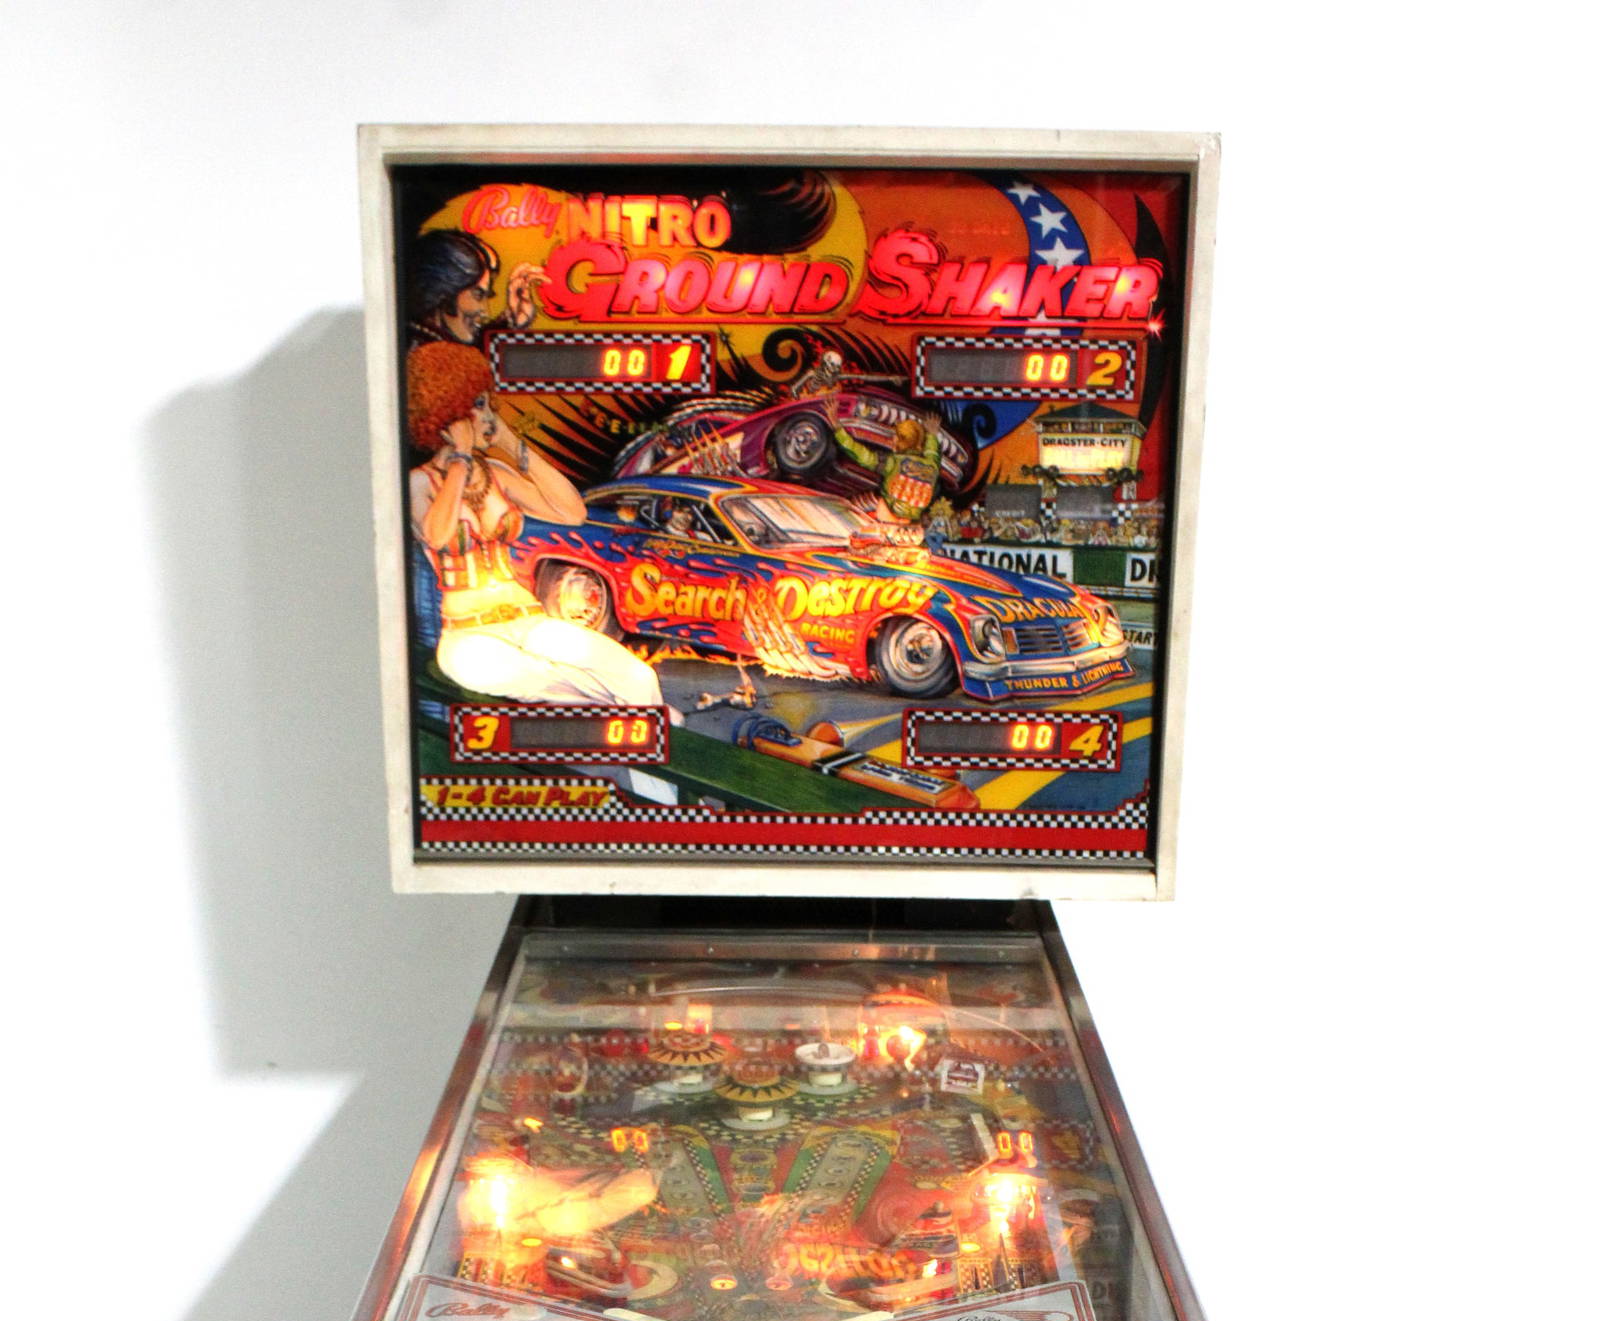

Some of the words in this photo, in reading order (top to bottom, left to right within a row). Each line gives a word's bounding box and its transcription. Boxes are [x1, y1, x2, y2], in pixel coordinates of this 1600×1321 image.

[463, 185, 562, 239] Bally
[568, 194, 732, 249] NITRO
[539, 241, 850, 322] GROUND
[852, 229, 1162, 320] SHAKER
[602, 348, 647, 377] 00
[666, 345, 691, 380] 1
[1025, 354, 1070, 381] 00
[1086, 352, 1122, 386] 2
[625, 563, 747, 620] Search
[774, 575, 938, 622] Destroy
[801, 621, 855, 643] RACING
[1004, 676, 1068, 690] THUNDER
[467, 716, 499, 750] 3
[607, 719, 648, 746] 00
[1011, 723, 1053, 750] 00
[1069, 724, 1104, 757] 4
[543, 786, 607, 807] PLAY
[425, 1302, 510, 1319] Bally
